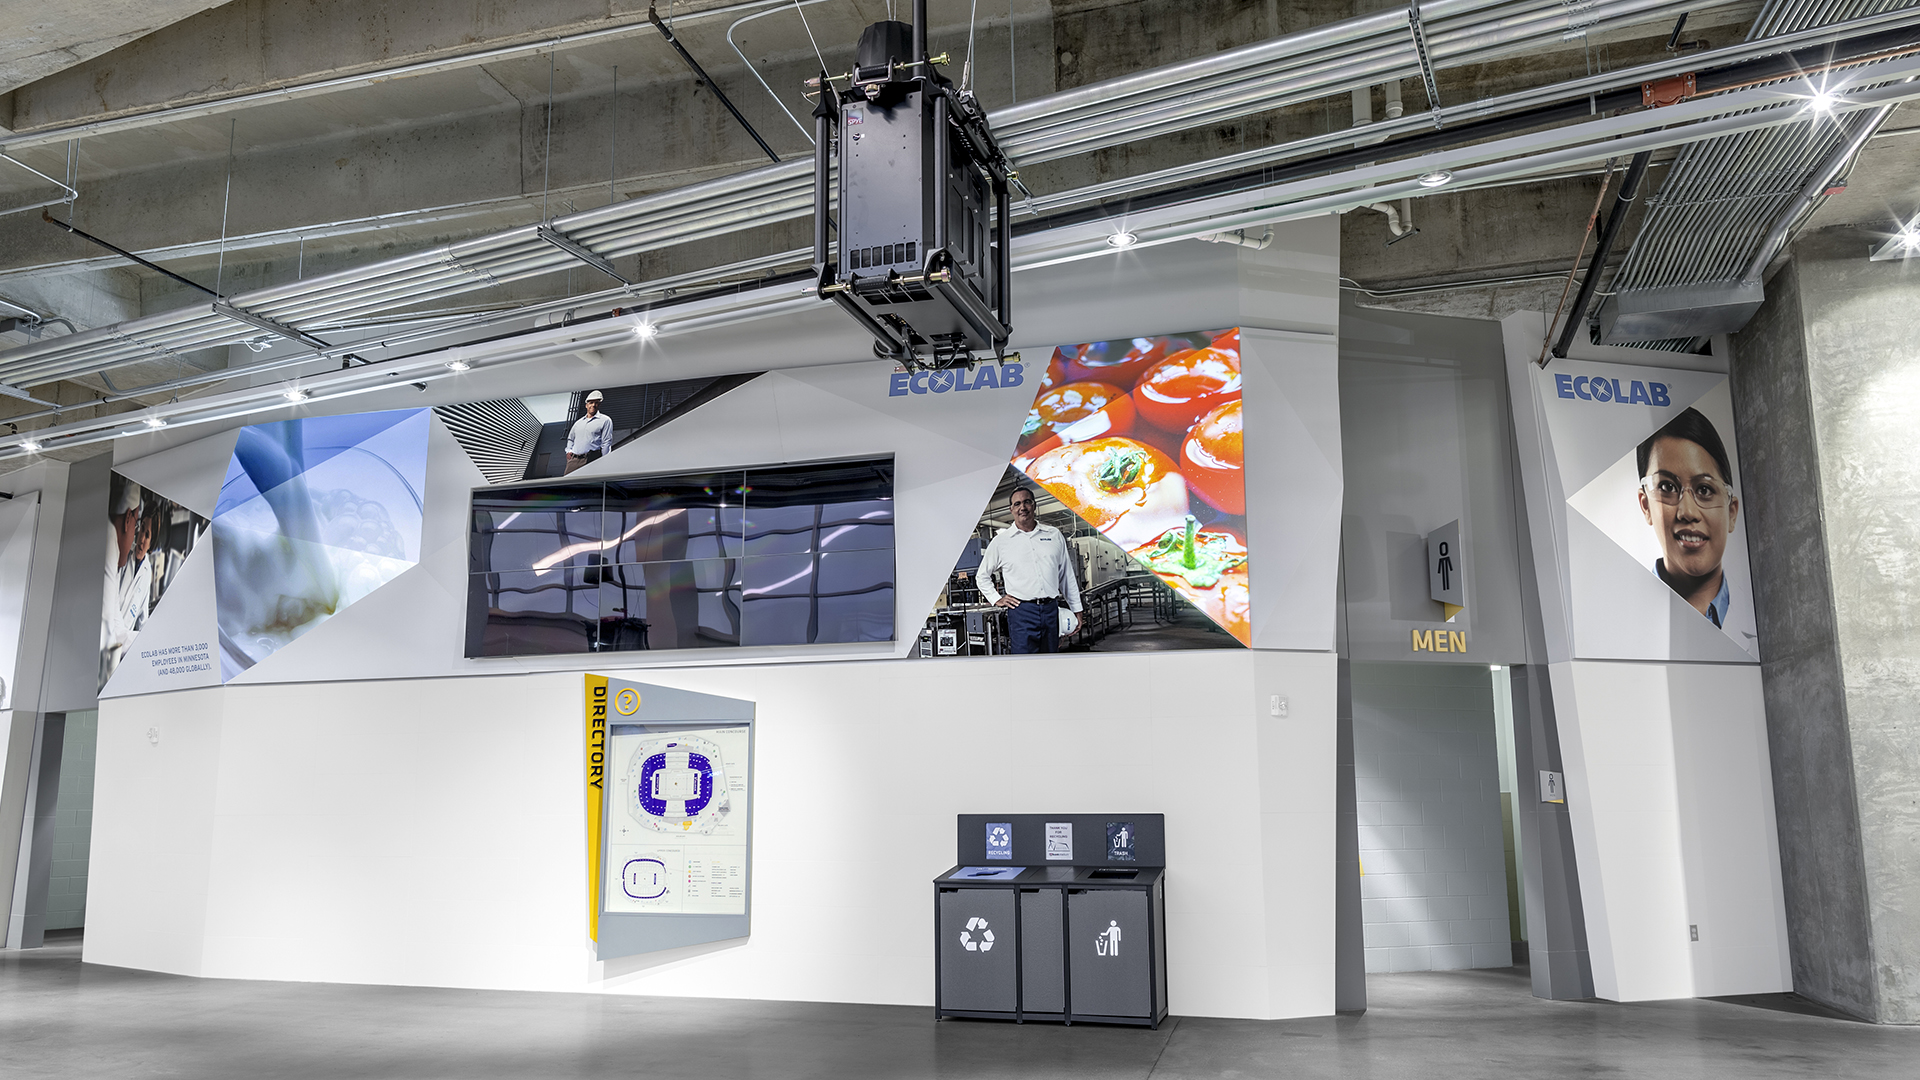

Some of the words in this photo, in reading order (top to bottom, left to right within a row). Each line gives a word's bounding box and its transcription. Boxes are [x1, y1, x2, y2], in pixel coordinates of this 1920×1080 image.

[889, 363, 1024, 397] ECOLAB
[1554, 373, 1671, 407] ECOLAB
[141, 650, 158, 659] ECOLAB
[168, 646, 181, 655] MORE
[181, 645, 194, 653] THAN
[194, 642, 208, 651] 3,000
[1412, 629, 1467, 653] MEN
[152, 657, 177, 667] EMPLOYEES
[177, 656, 183, 664] IN
[183, 653, 209, 662] MINNESOTA
[157, 668, 168, 676] (AND
[169, 666, 185, 675] 48,000
[185, 663, 212, 672] GLOBALLY).
[590, 686, 606, 789] DIRECTORY
